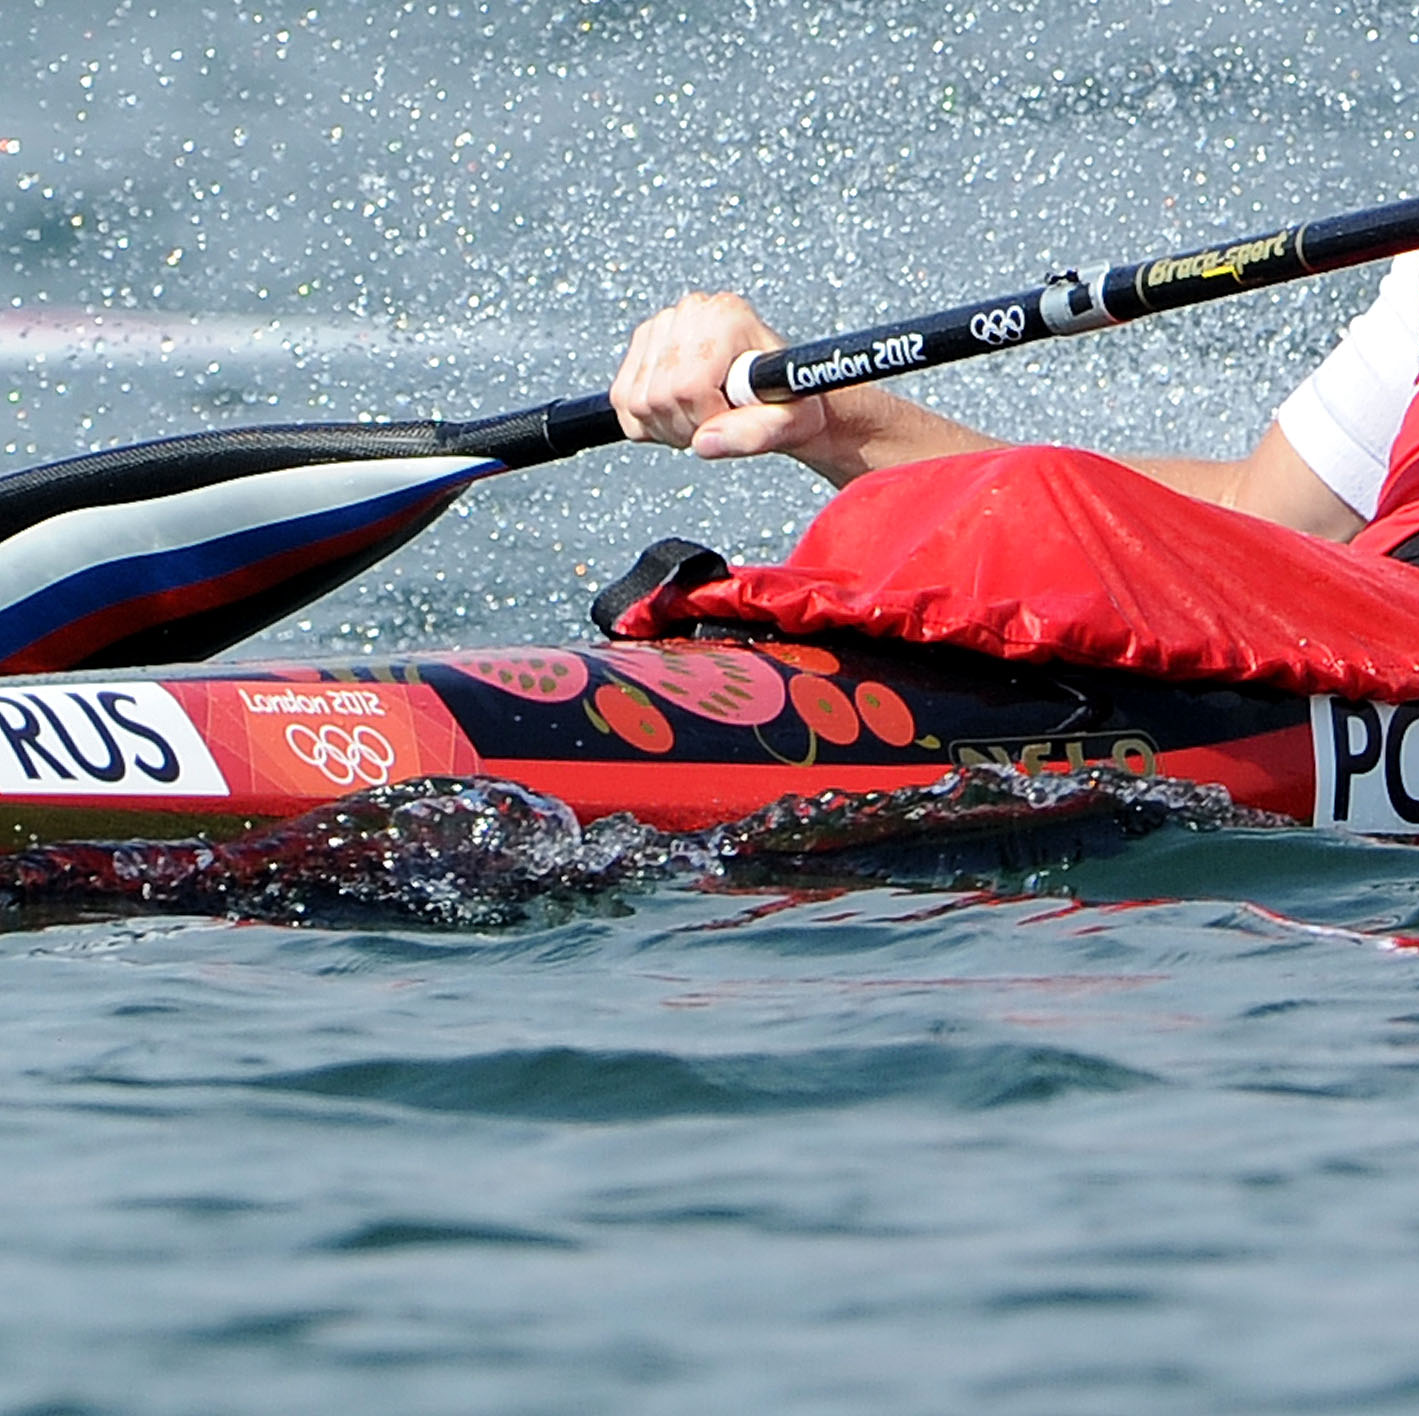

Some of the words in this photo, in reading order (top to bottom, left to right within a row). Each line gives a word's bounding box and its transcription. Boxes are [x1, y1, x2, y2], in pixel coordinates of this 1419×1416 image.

[787, 348, 873, 392] London
[872, 333, 927, 370] 2012
[238, 689, 331, 715] London
[326, 690, 386, 716] 2012
[0, 691, 180, 784] RUS
